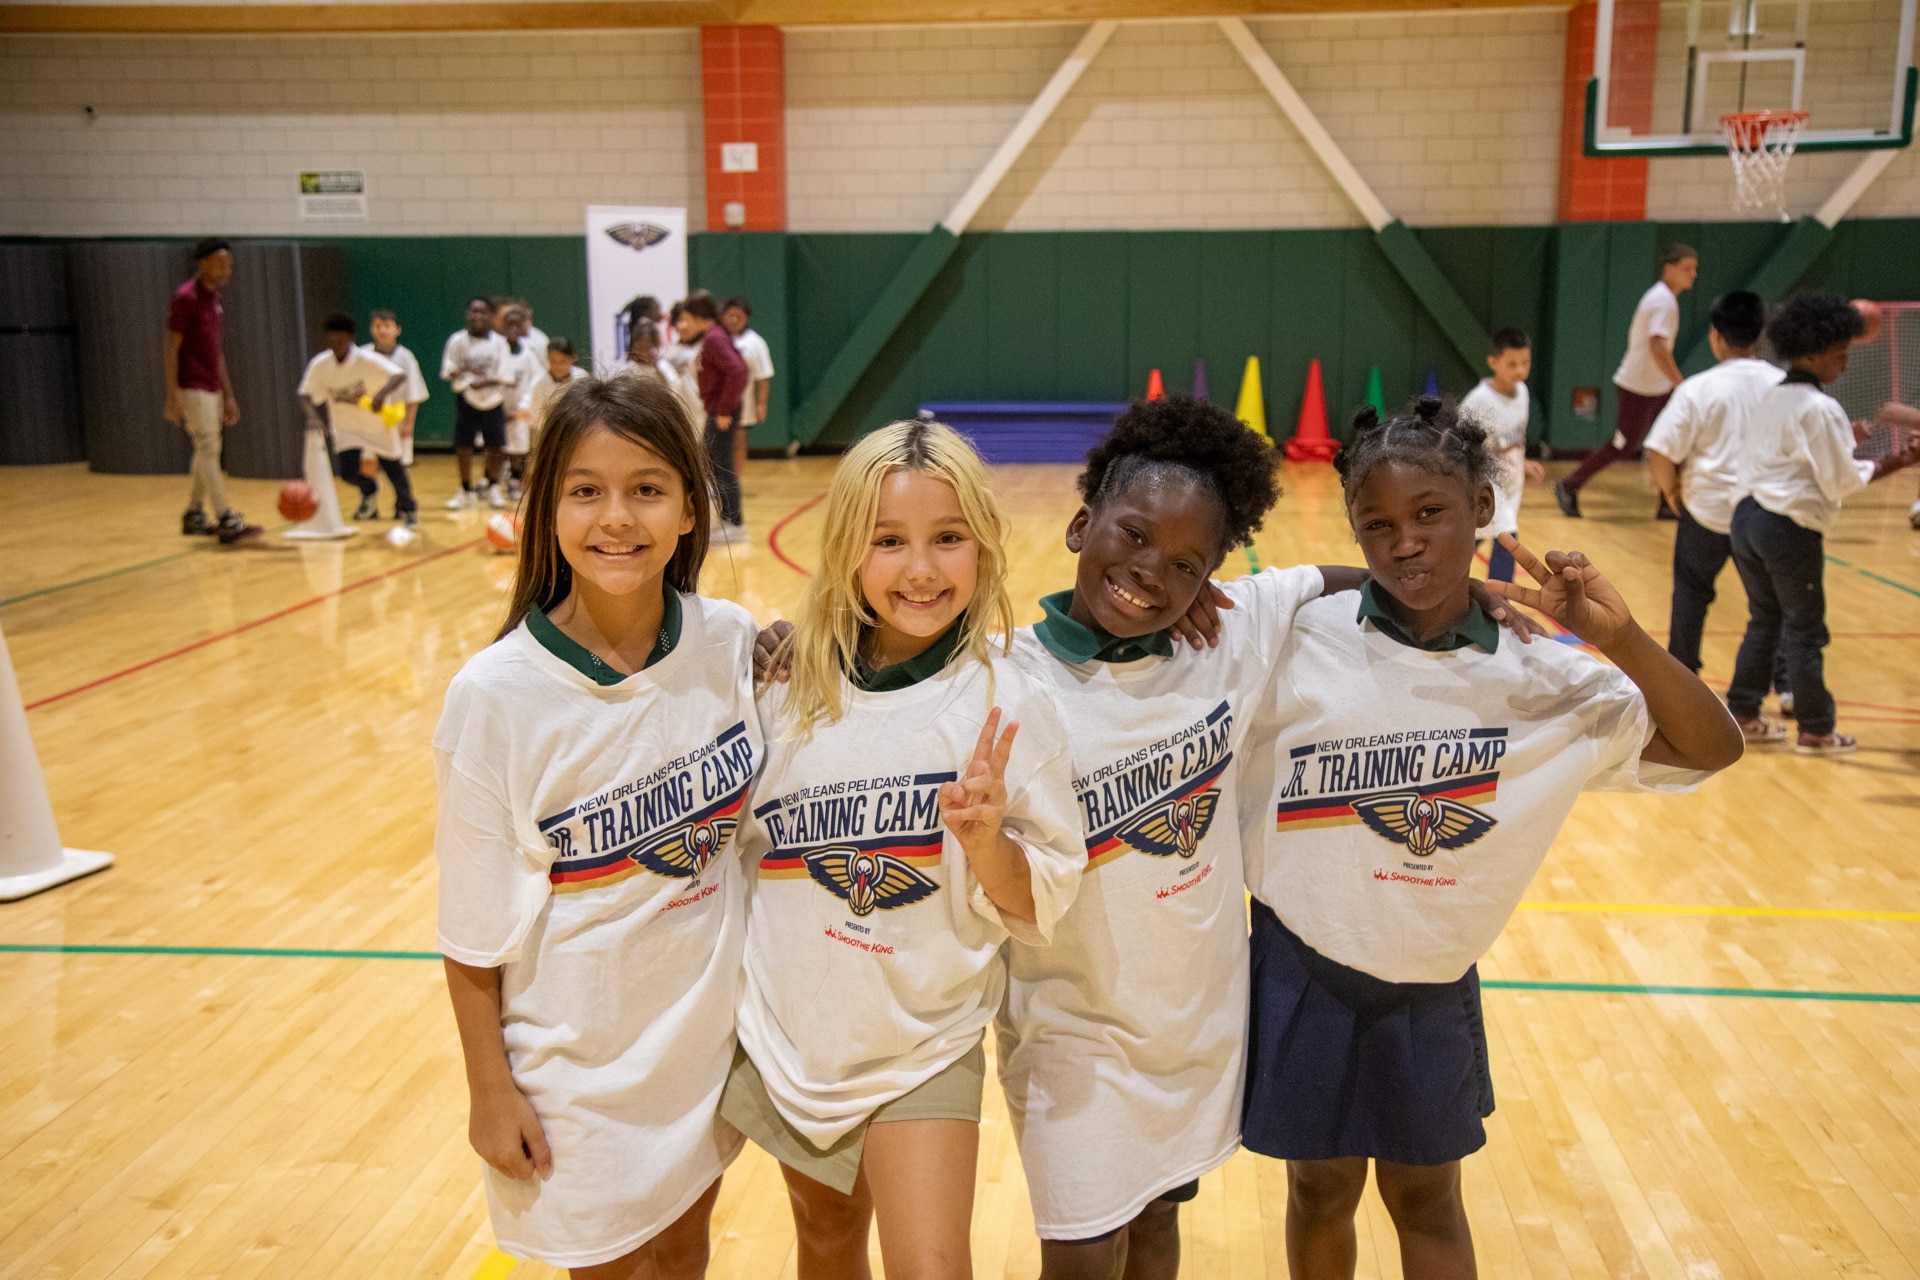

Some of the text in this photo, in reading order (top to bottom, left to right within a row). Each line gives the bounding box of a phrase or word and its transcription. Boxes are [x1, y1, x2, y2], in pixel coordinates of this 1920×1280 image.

[1071, 720, 1205, 792] EW ORLEANS PELICANS
[1317, 728, 1467, 753] NEW ORLEANS PELICANS
[578, 739, 717, 814] NEW ORLEANS PELICANS
[1281, 739, 1507, 799] JR. TRAINING CAMP
[583, 770, 694, 854] TRAINING
[701, 736, 754, 802] CAMP
[781, 791, 800, 808] NEW
[847, 775, 911, 793] PELICANS
[874, 788, 941, 834] CAM
[1077, 752, 1174, 833] RAINING
[1390, 872, 1434, 886] SMOOTHIE
[1403, 862, 1427, 871] PRESENTED
[838, 931, 871, 951] SMOOTHIE
[845, 920, 865, 933] PRESENTED
